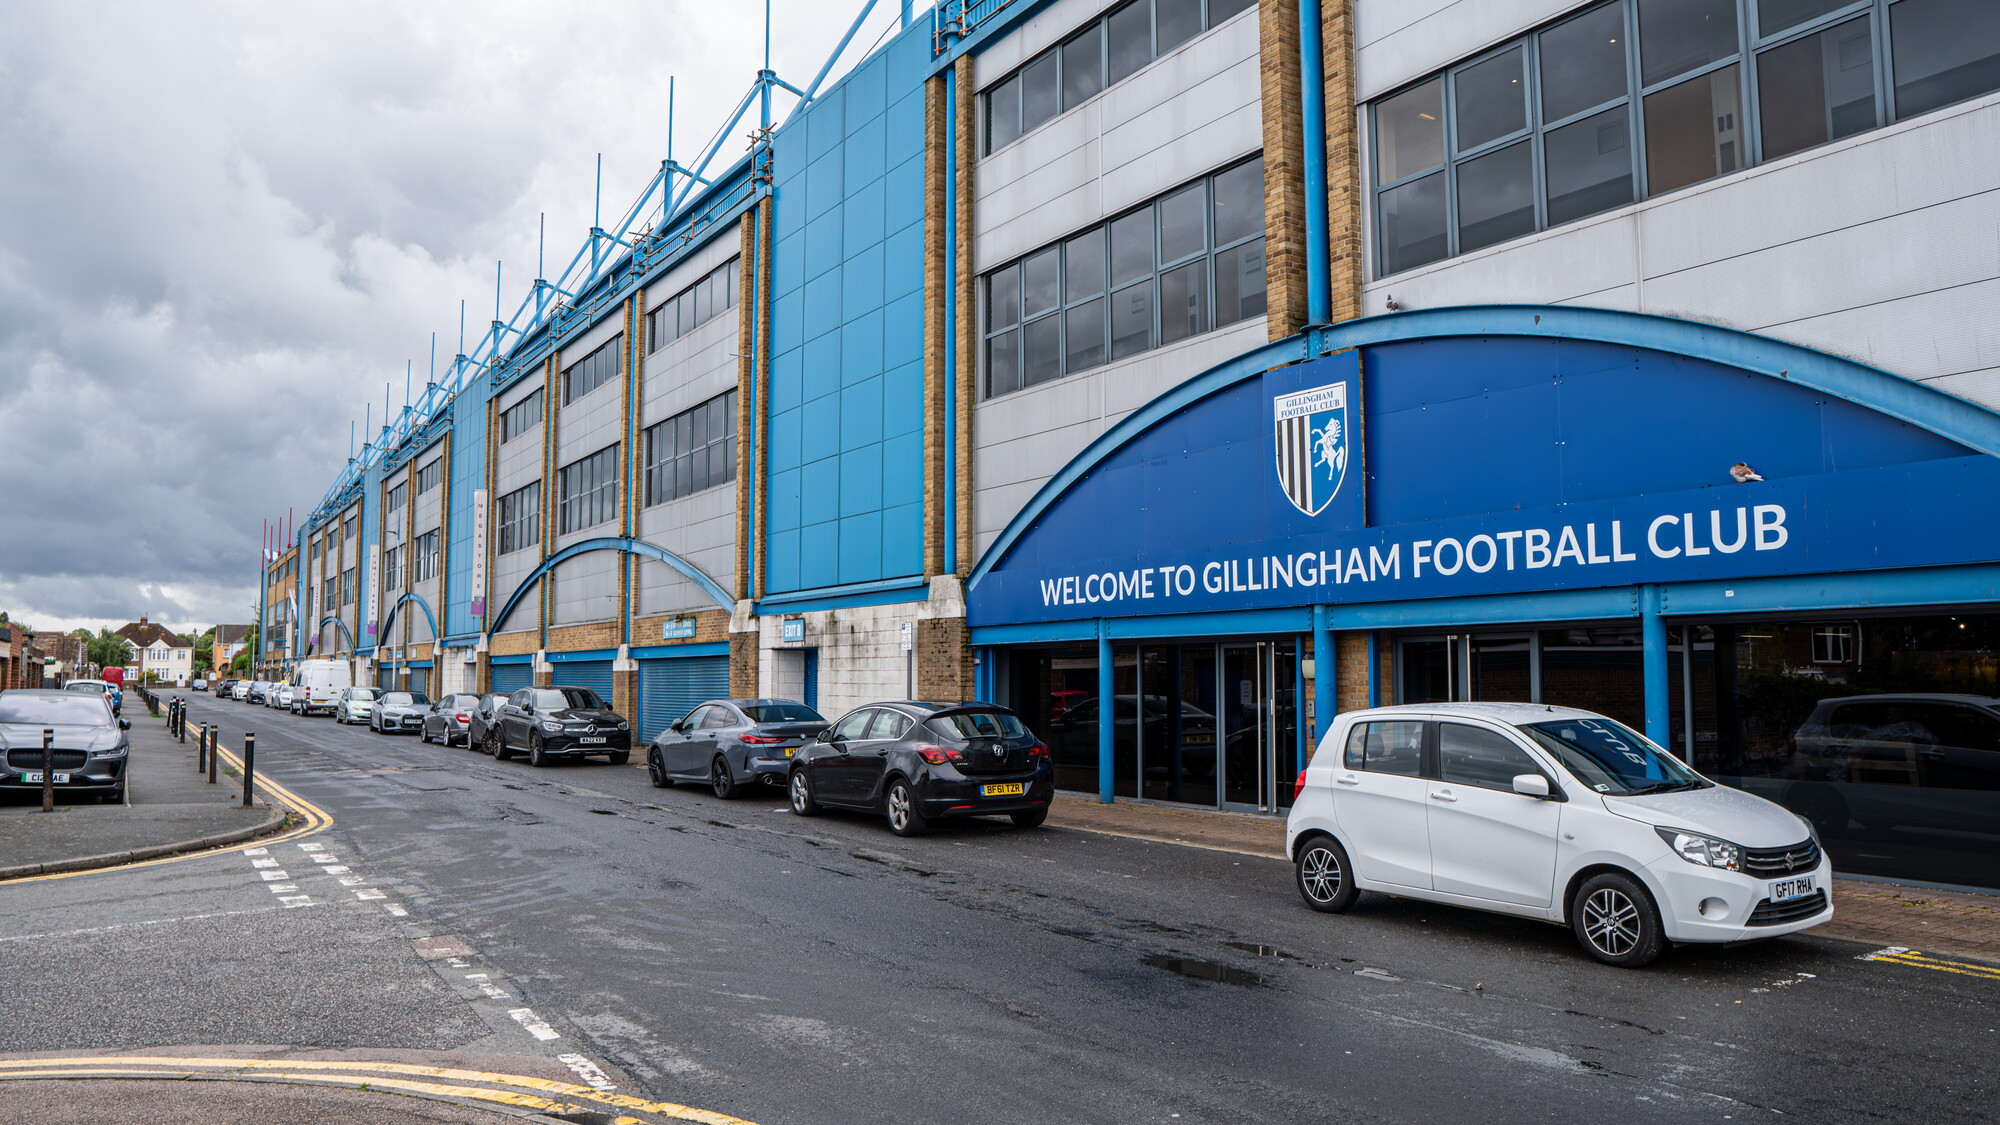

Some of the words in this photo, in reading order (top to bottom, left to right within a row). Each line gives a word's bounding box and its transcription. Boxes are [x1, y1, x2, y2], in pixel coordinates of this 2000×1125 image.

[1286, 391, 1334, 407] GILLINGHAM
[1281, 404, 1319, 418] FOOTBALL
[1320, 399, 1340, 409] CLUB
[1040, 568, 1155, 607] WELCOME
[1159, 564, 1196, 599] TO
[1202, 543, 1401, 594] GILLINGHAM
[1412, 520, 1636, 578] FOOTBALL
[1647, 504, 1789, 559] CLUB
[785, 624, 796, 637] EXIT
[987, 784, 1005, 794] BF61
[1005, 783, 1020, 793] TZR
[1775, 881, 1795, 898] GF17
[1797, 878, 1812, 894] RHA
